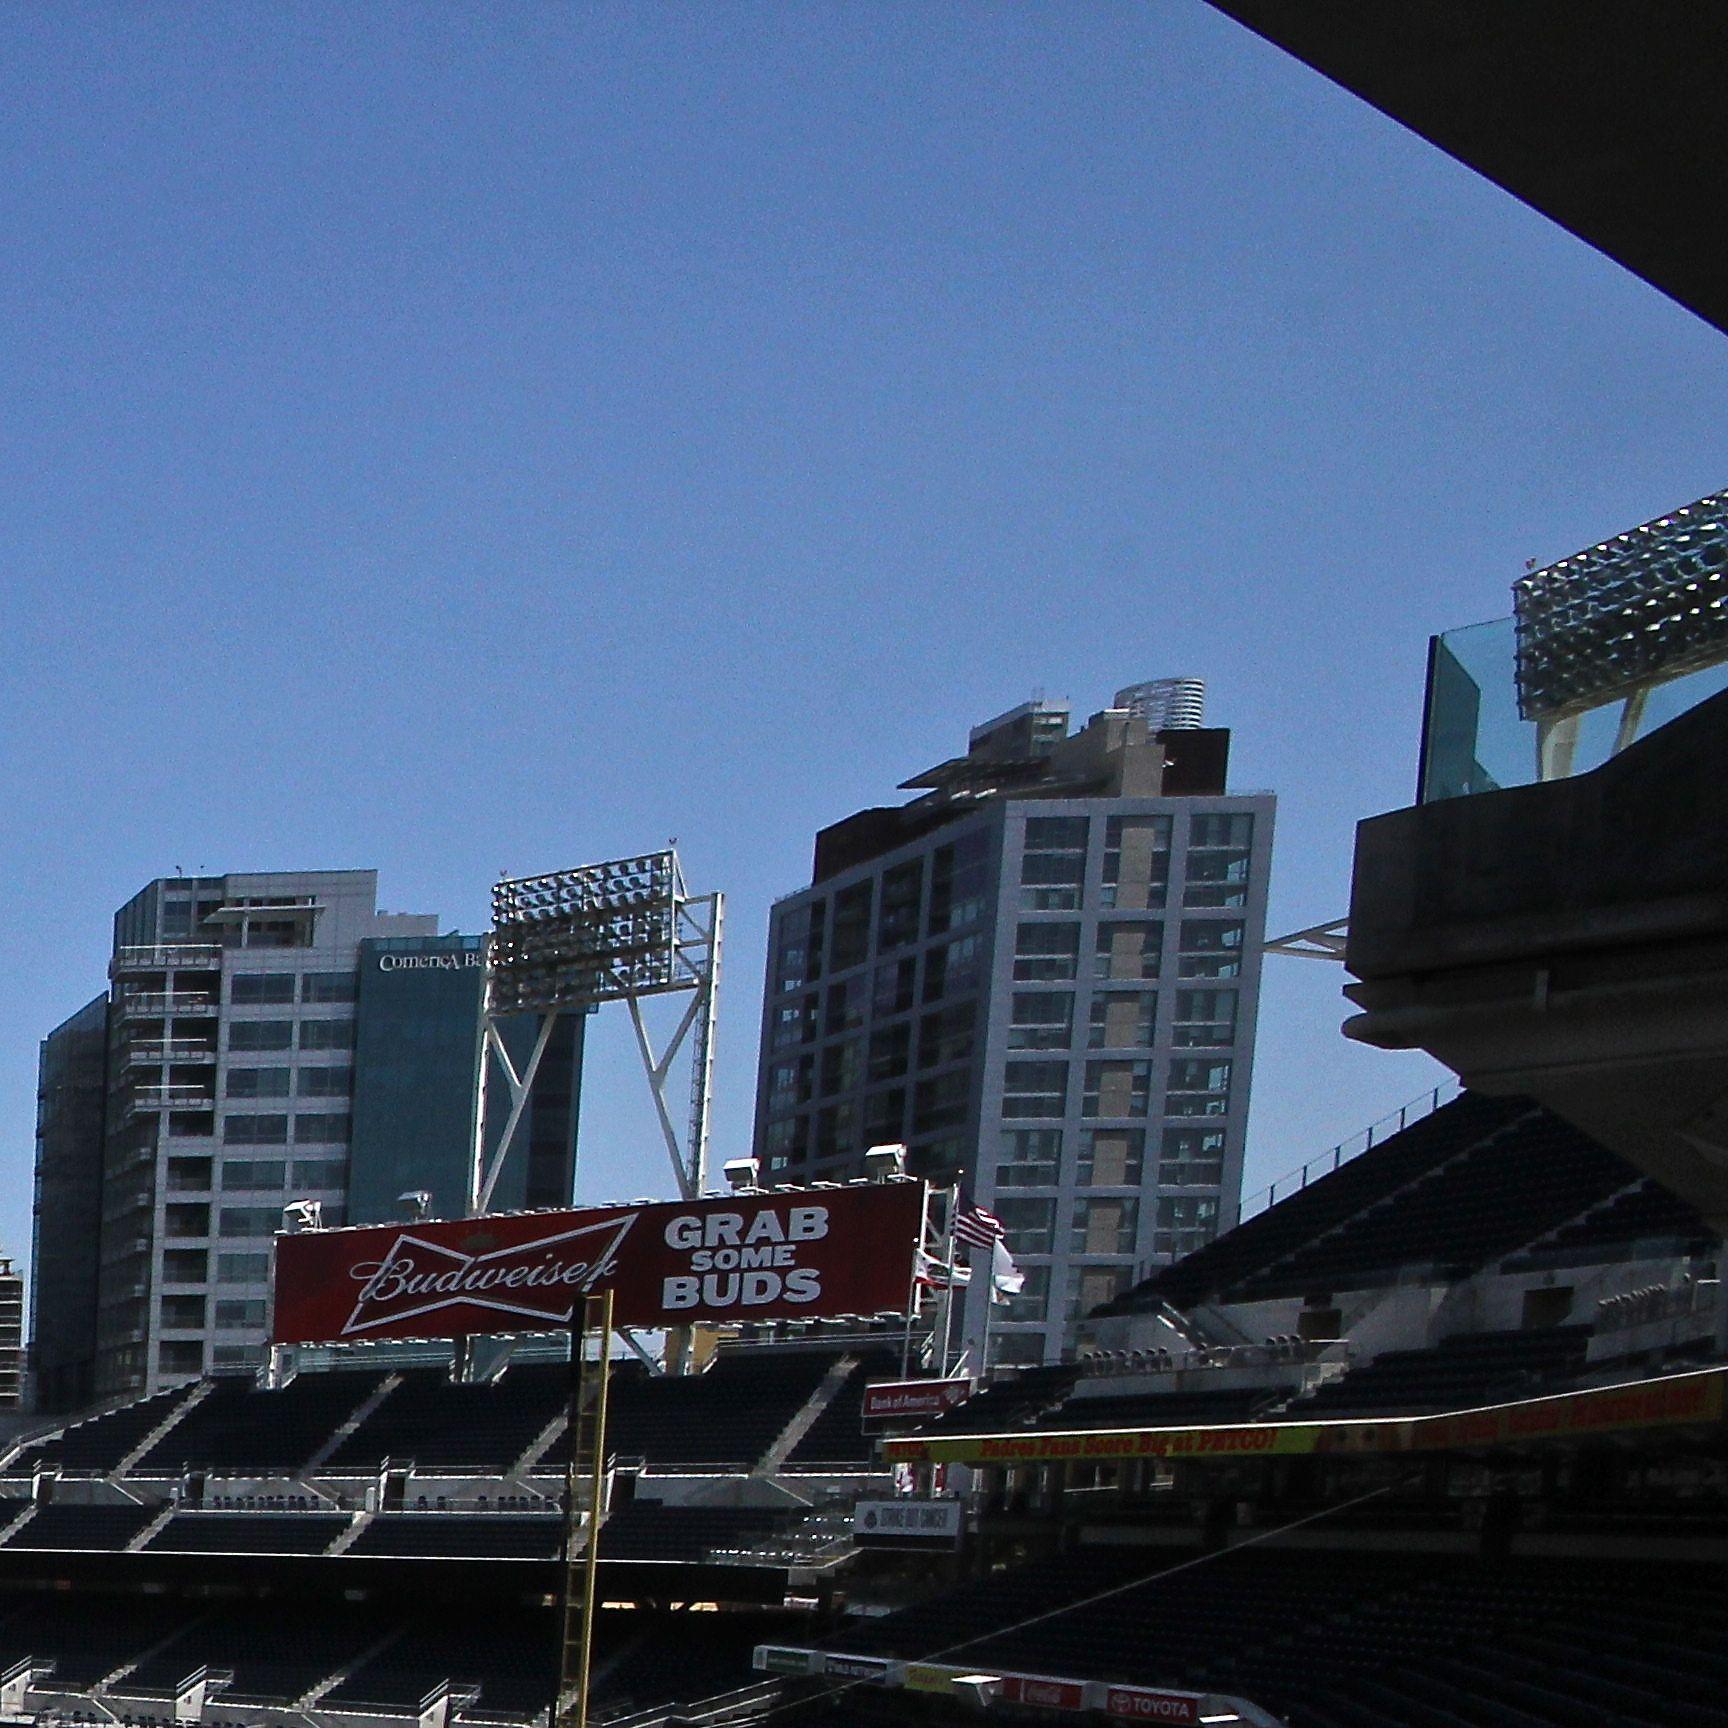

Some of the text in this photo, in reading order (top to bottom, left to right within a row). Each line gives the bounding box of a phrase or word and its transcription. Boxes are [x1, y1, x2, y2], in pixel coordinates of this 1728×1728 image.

[664, 1205, 829, 1251] GRAB
[350, 1253, 618, 1302] Budweiser
[690, 1244, 797, 1272] SOME
[661, 1269, 822, 1309] BUDS
[1133, 1697, 1191, 1718] TOYOTA
